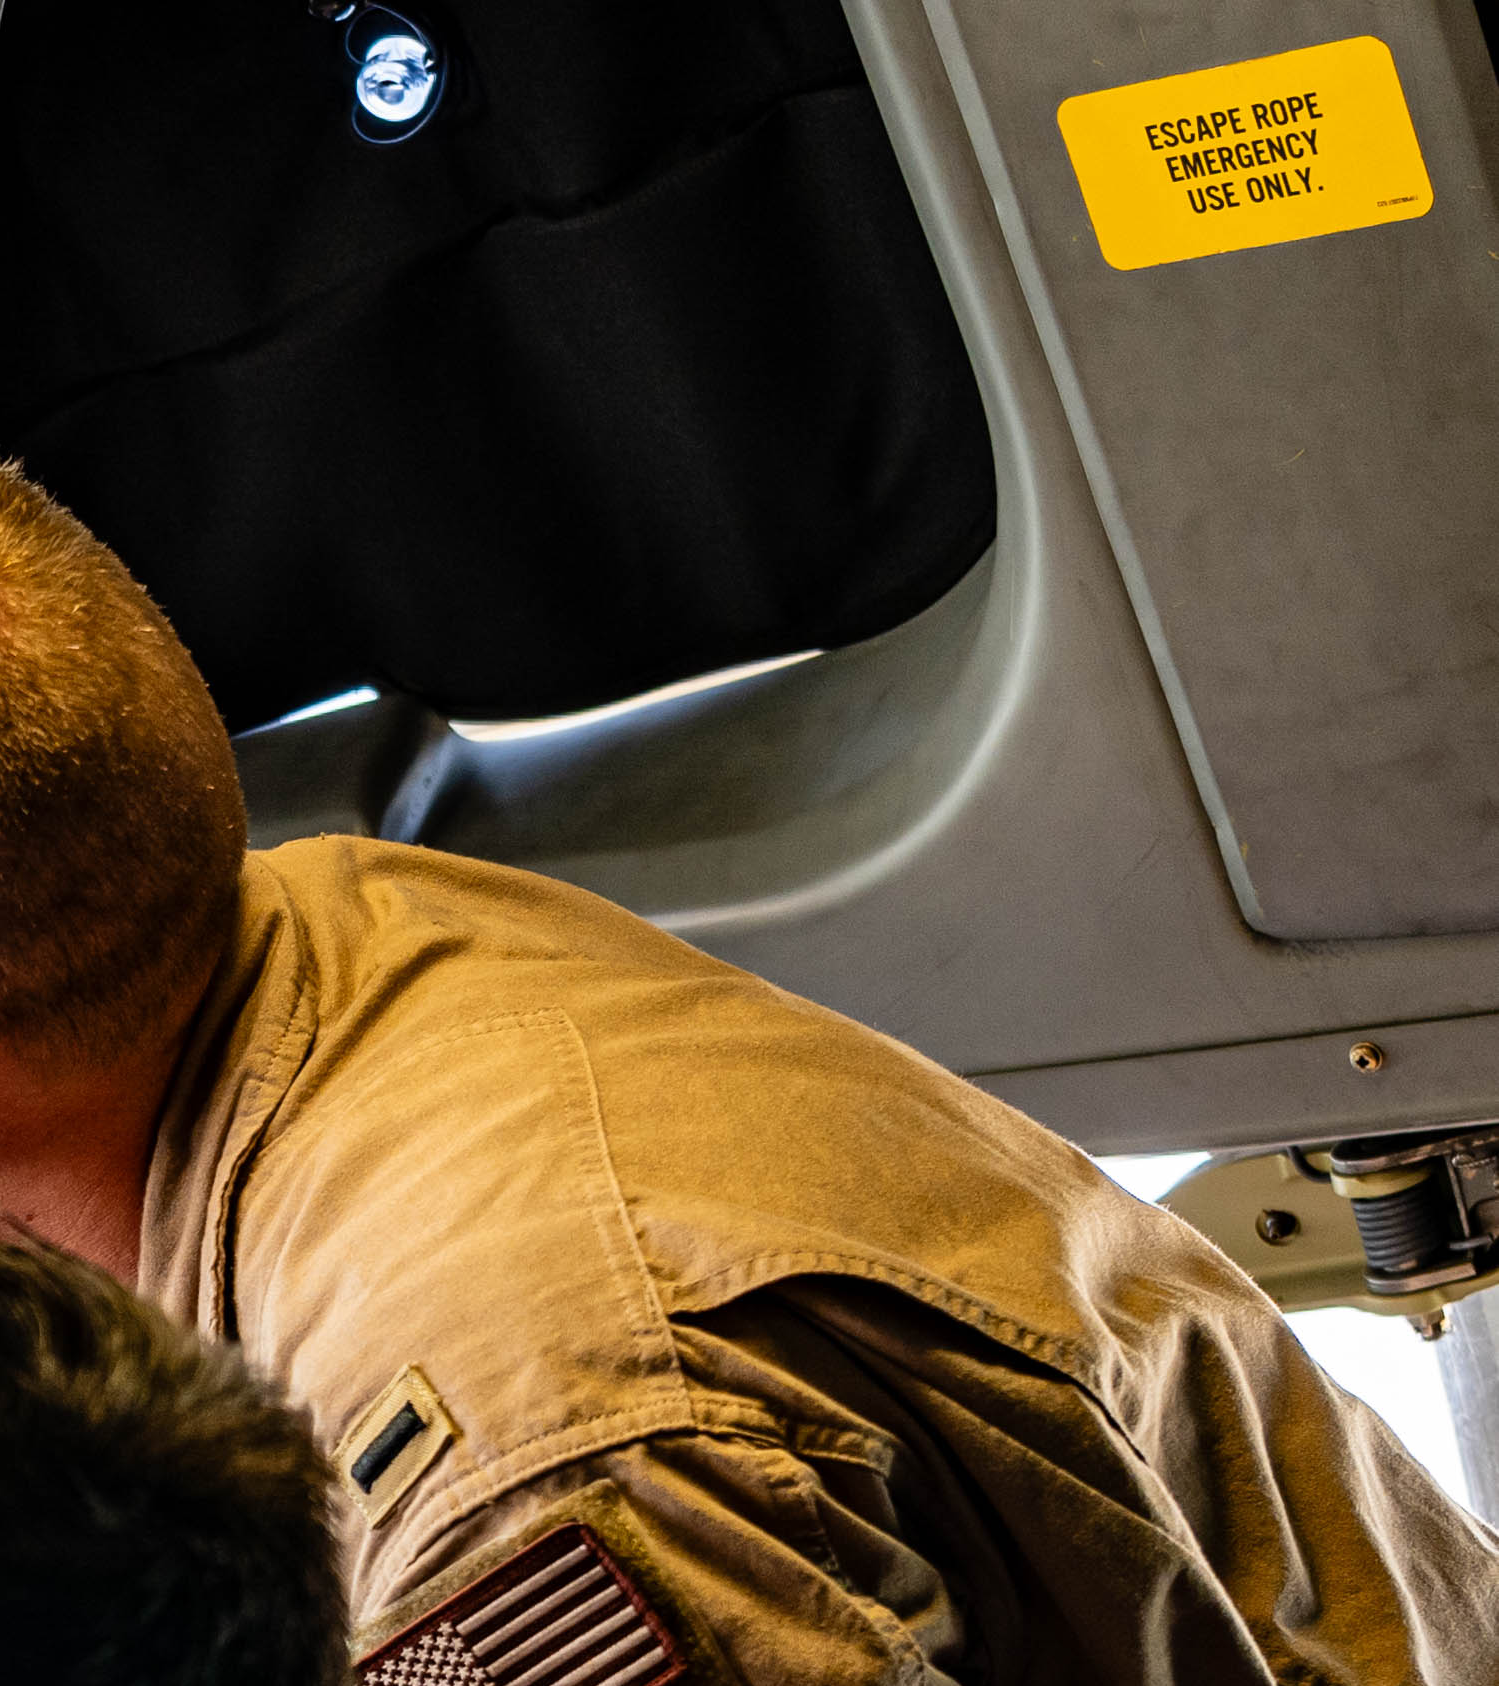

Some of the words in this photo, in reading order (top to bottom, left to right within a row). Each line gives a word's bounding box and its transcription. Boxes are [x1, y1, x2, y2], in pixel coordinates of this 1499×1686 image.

[1144, 108, 1246, 151] ESCAPE
[1251, 92, 1323, 130] ROPE
[1165, 129, 1318, 182] EMERGENCY
[1187, 182, 1240, 214] USE
[1246, 167, 1324, 203] ONLY.
